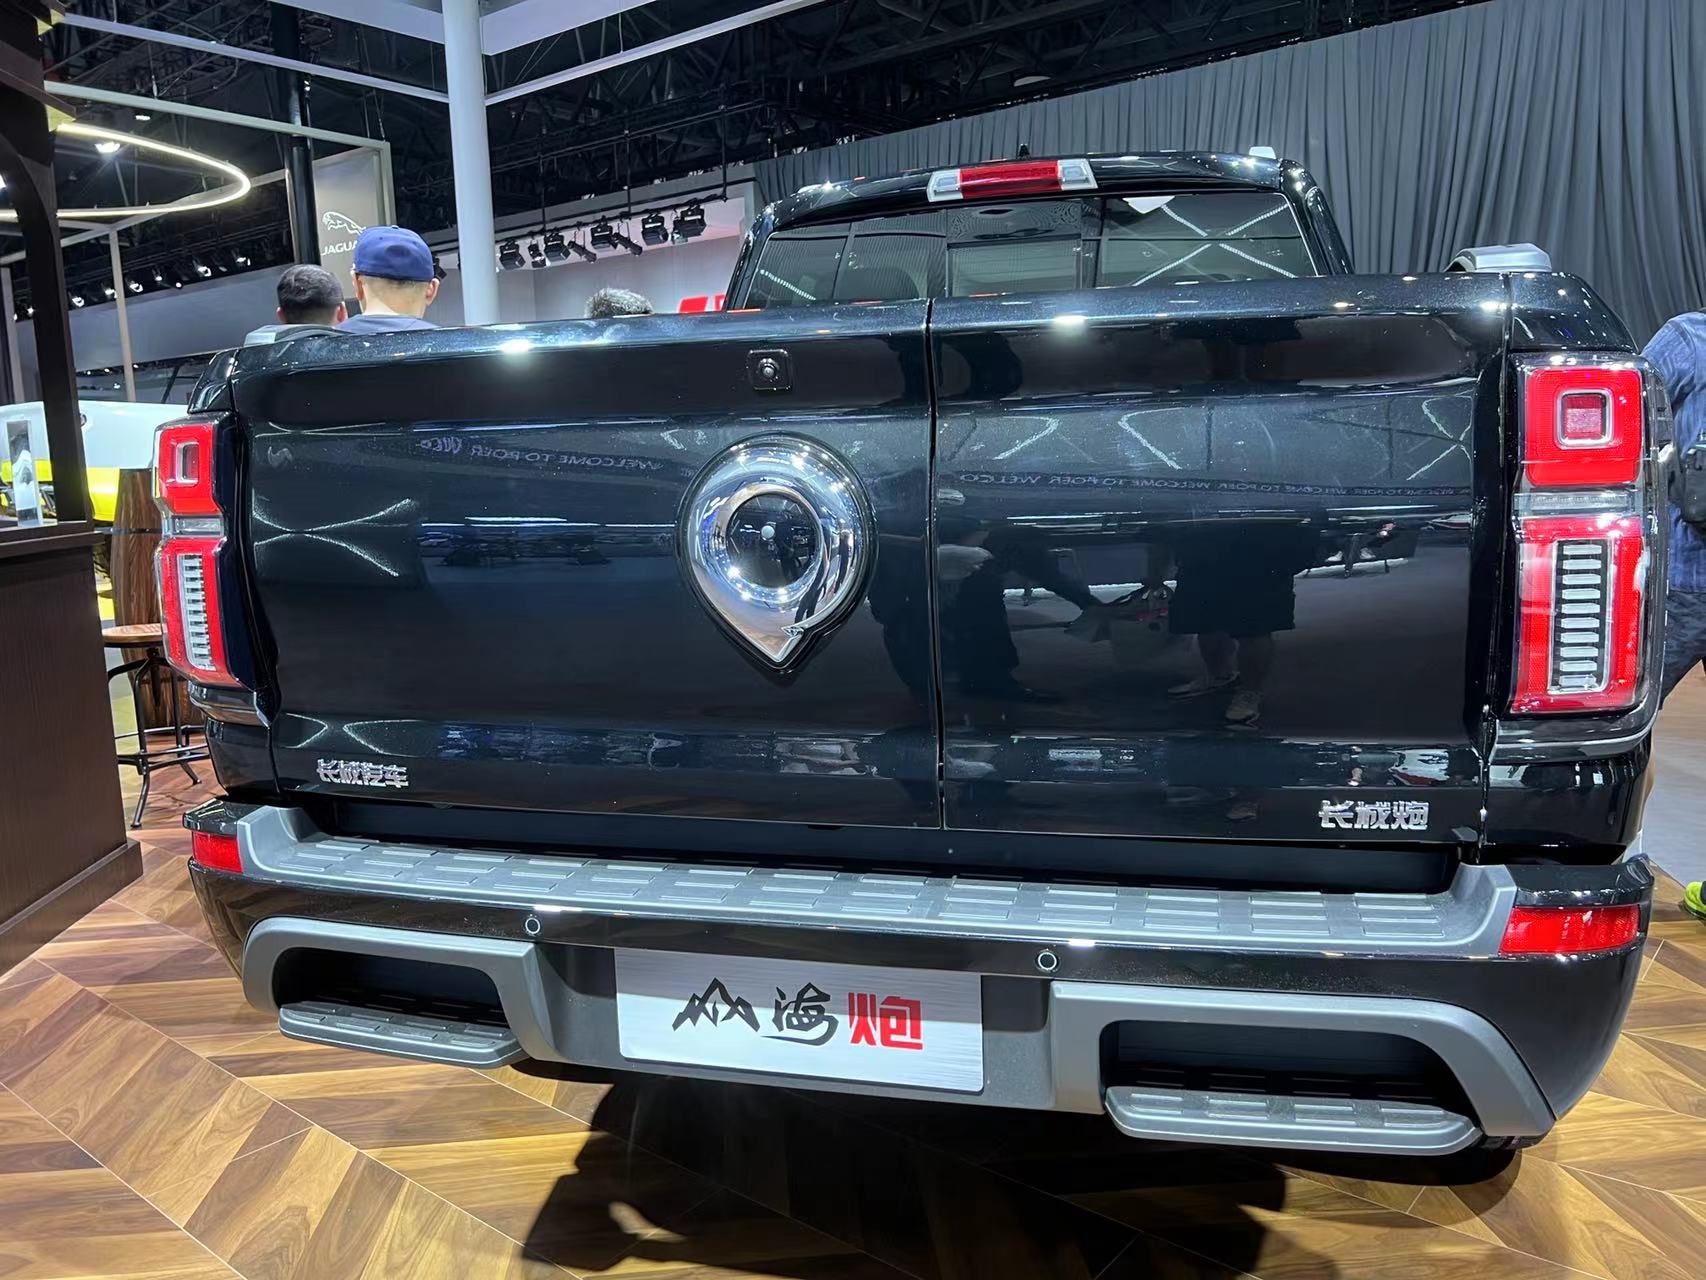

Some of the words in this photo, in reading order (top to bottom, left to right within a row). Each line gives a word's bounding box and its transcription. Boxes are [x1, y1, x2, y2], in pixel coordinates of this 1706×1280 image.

[316, 758, 409, 789] 长城汽车
[1318, 800, 1430, 831] 长城炮
[671, 976, 924, 1051] 山海炮
